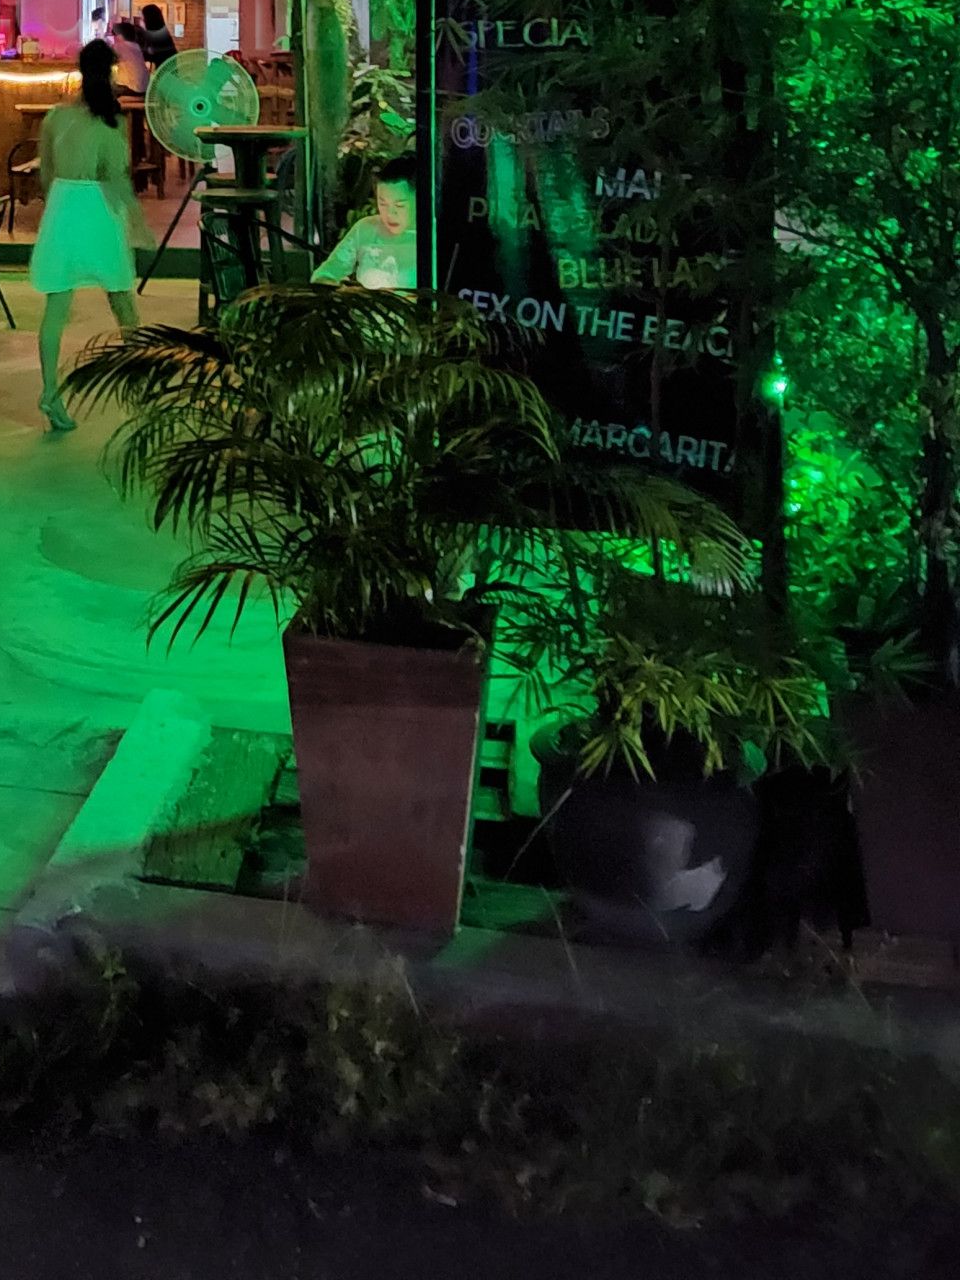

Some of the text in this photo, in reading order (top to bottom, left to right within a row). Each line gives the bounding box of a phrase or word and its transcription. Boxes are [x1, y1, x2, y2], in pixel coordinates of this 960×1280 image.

[515, 297, 566, 333] ON
[576, 305, 637, 343] THE
[641, 314, 733, 358] BEAC
